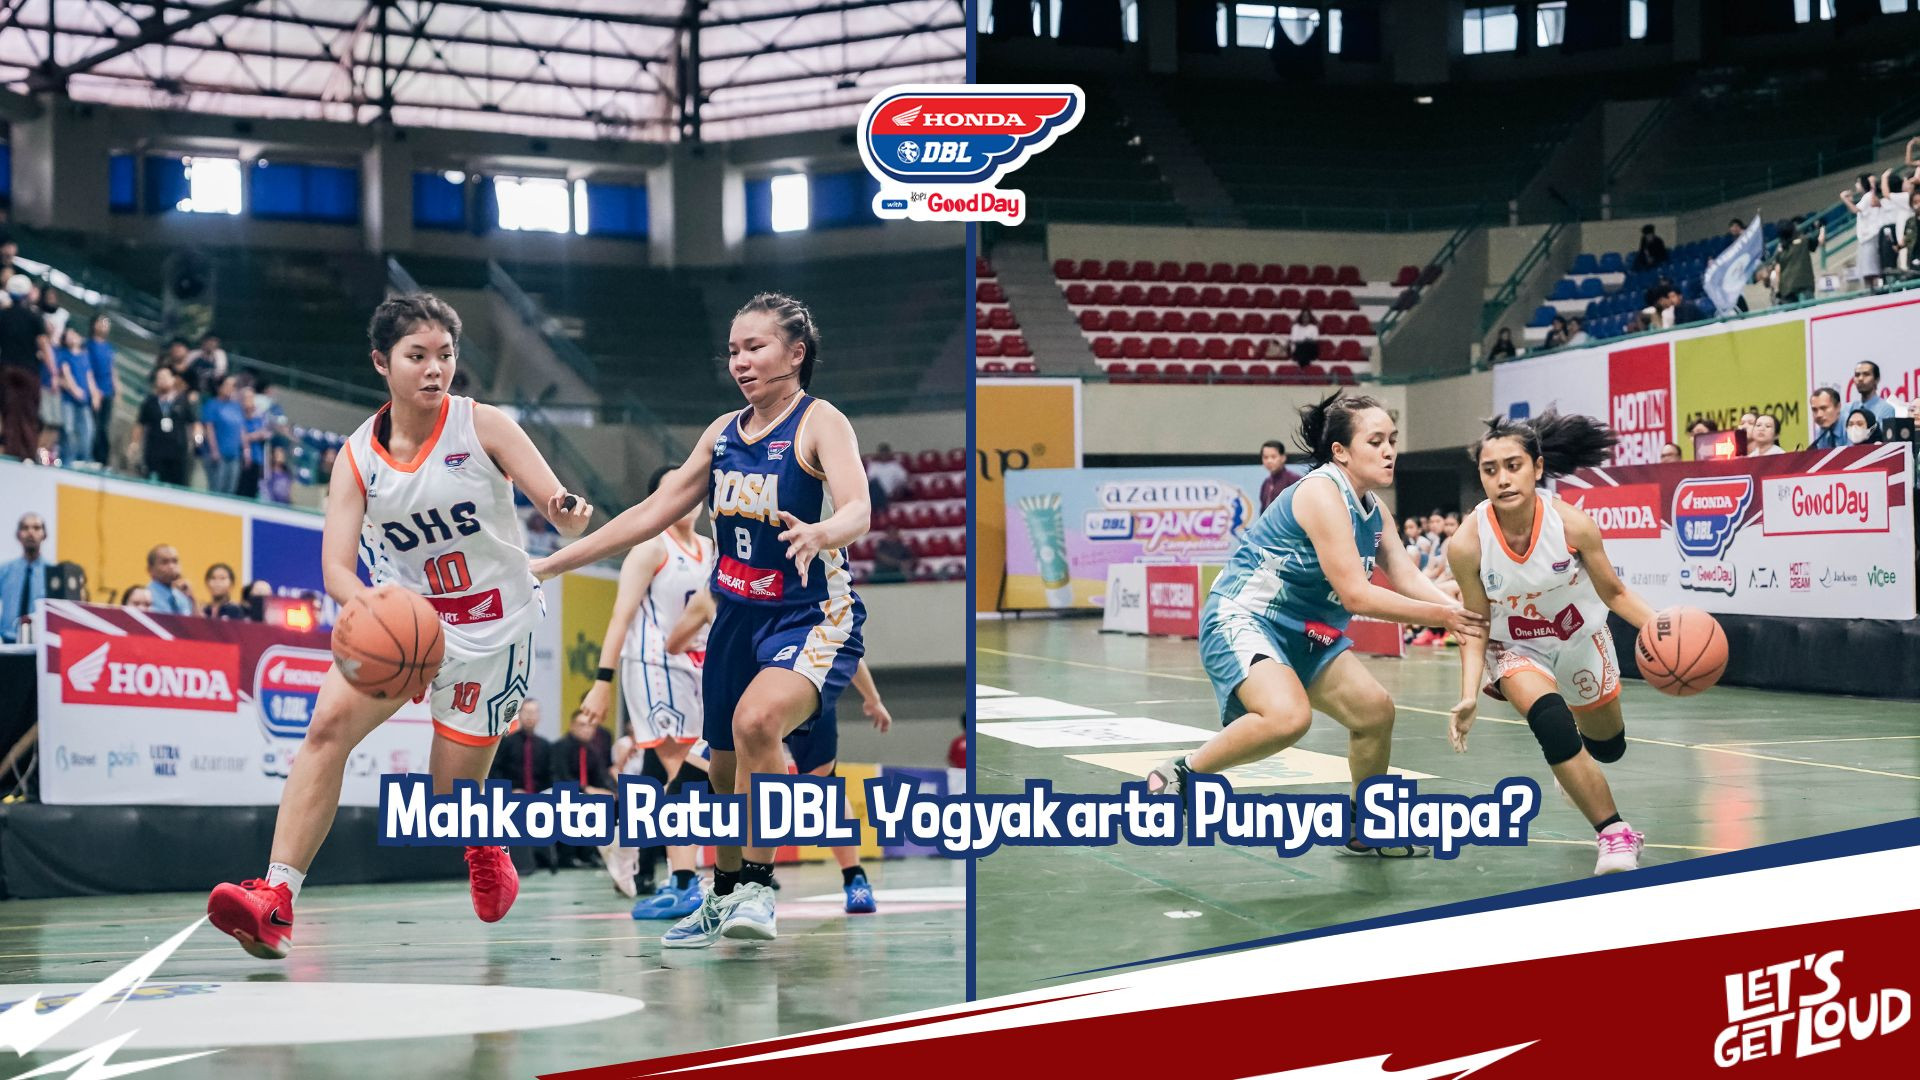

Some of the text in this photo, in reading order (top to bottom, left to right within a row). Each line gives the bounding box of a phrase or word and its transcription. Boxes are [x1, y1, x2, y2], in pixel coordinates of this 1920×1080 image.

[1613, 392, 1647, 431] HOT
[1583, 505, 1658, 531] HONDA
[1692, 495, 1733, 510] HONDA
[381, 501, 481, 552] DHS
[1101, 510, 1229, 546] DBL DANCE
[1693, 521, 1713, 541] DBL
[734, 527, 752, 560] 8
[424, 551, 473, 596] 10
[1307, 629, 1323, 641] One
[1515, 627, 1532, 637] One
[108, 662, 234, 701] HONDA
[450, 681, 482, 714] 10
[1573, 669, 1600, 699] 3
